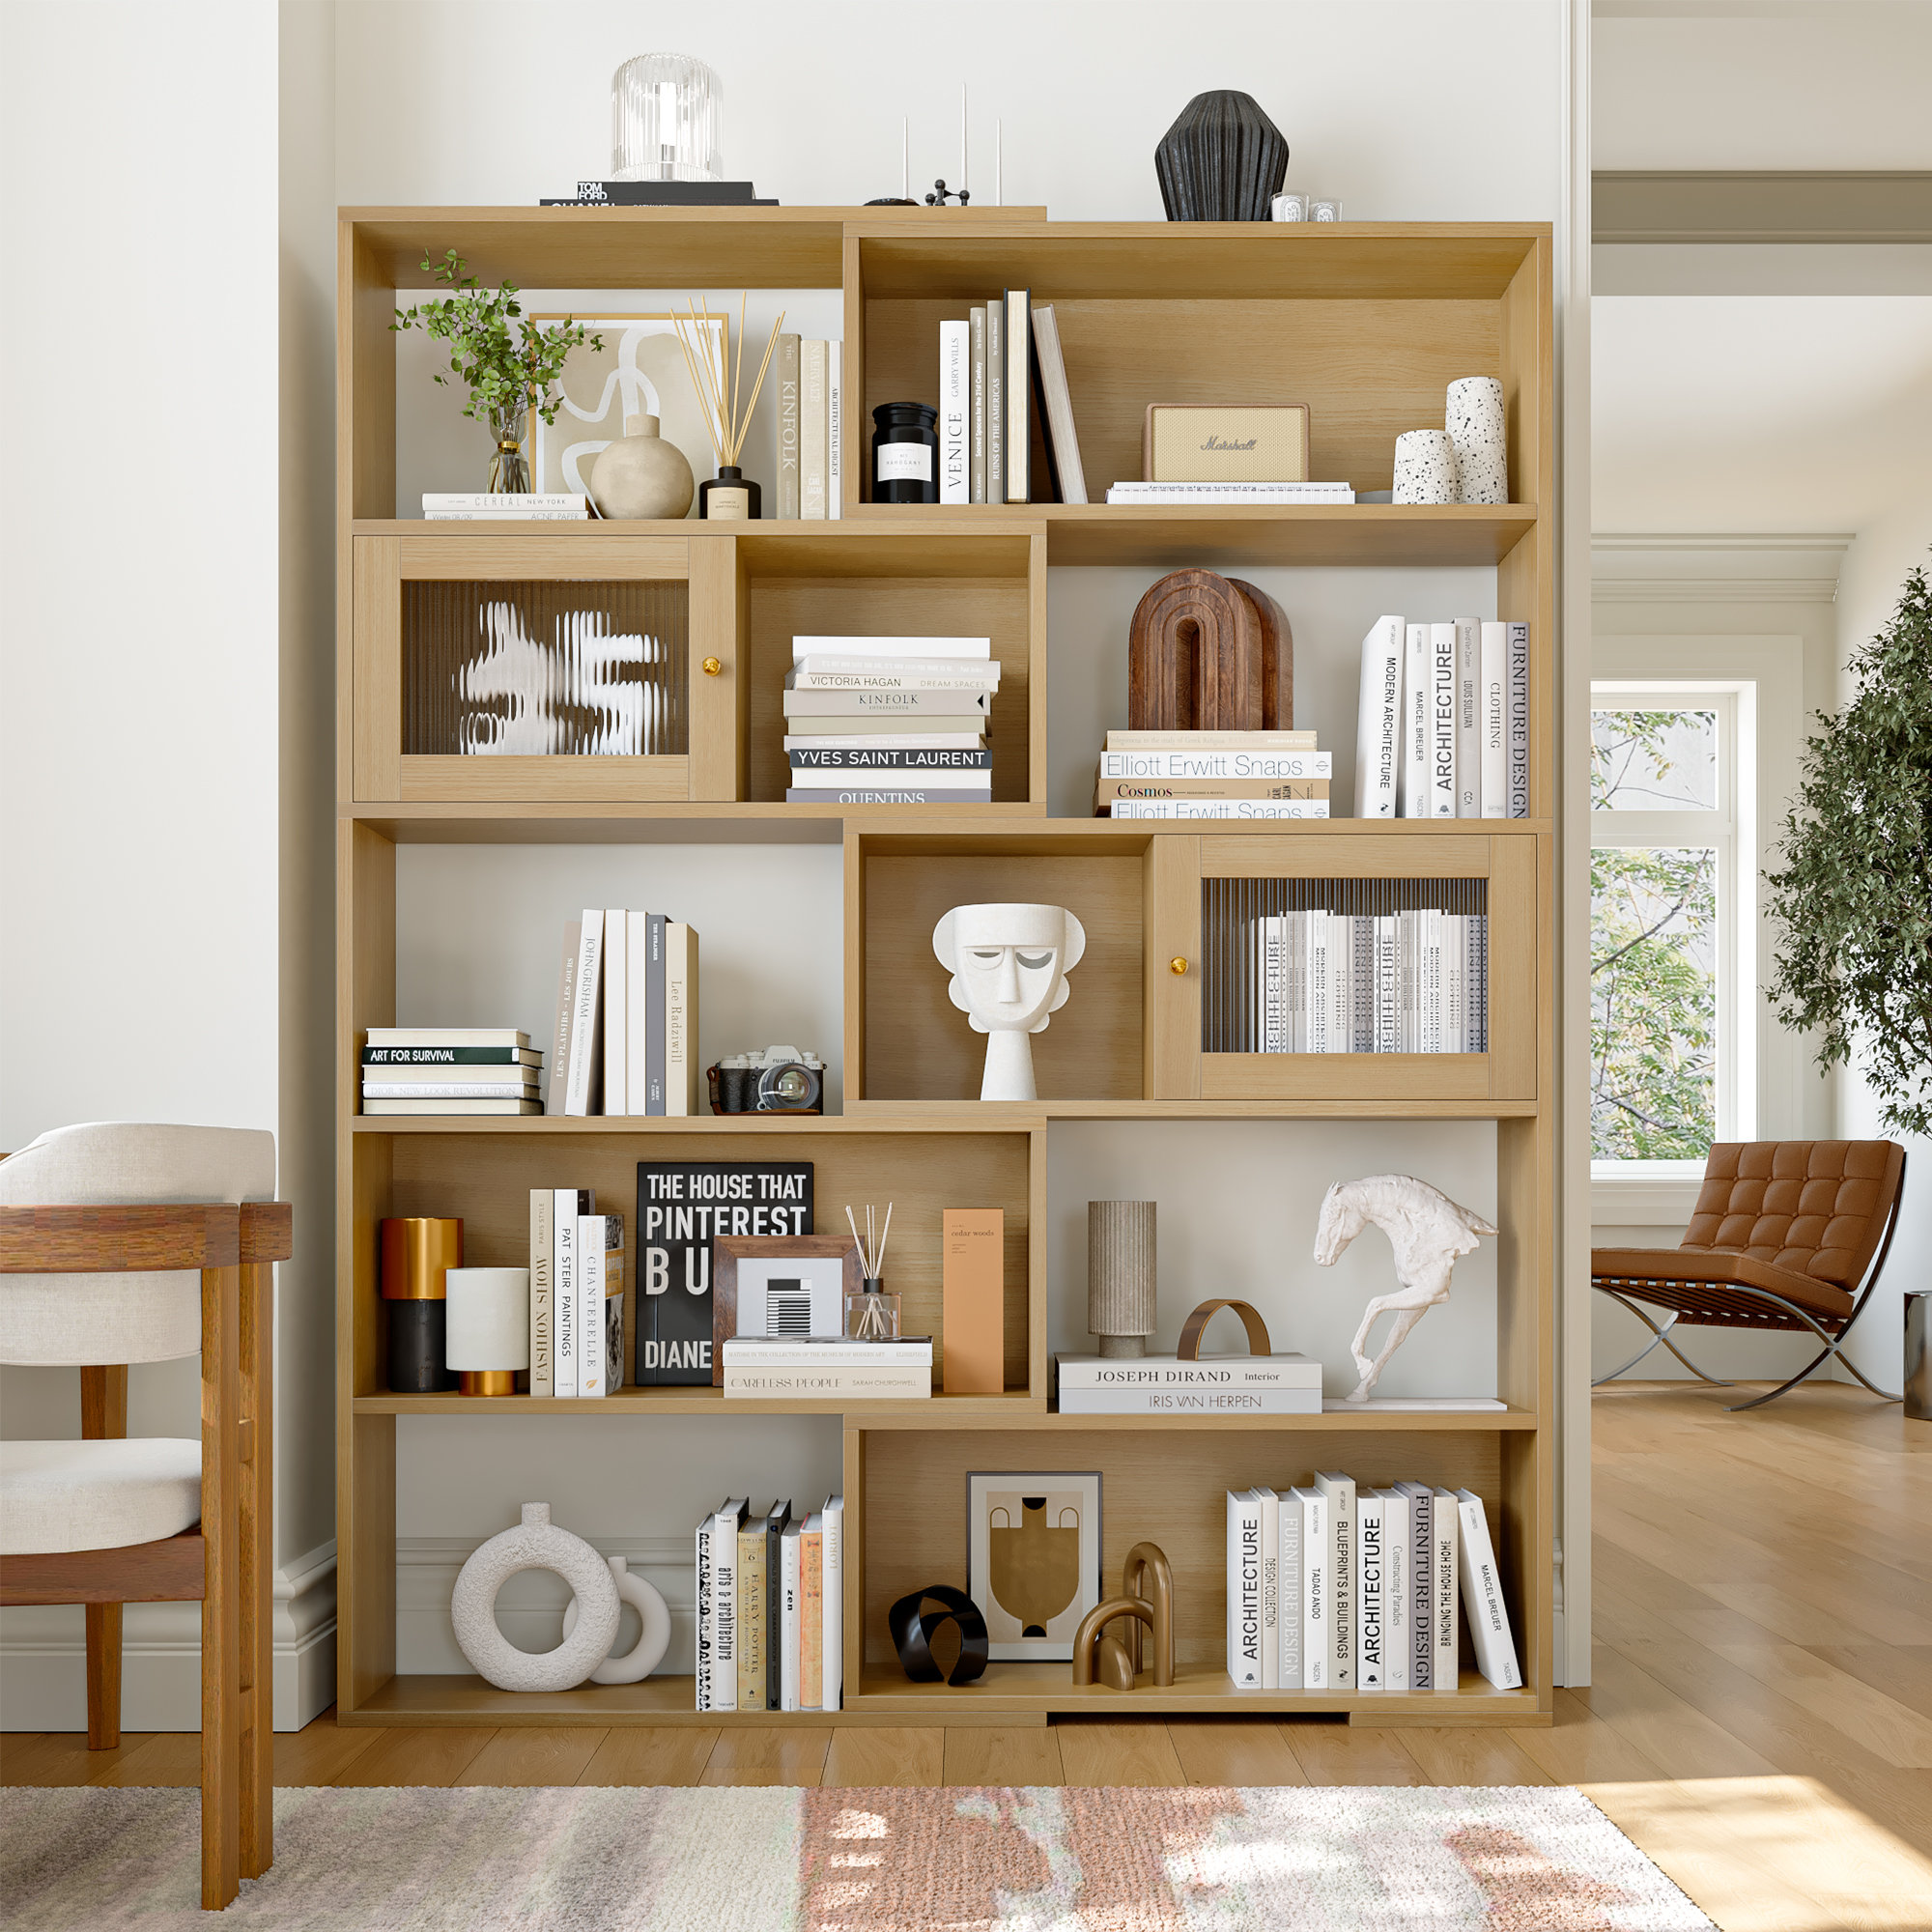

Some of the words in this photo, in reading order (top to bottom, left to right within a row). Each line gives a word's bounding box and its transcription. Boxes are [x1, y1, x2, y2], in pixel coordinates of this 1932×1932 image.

[578, 182, 603, 191] TOM
[578, 191, 608, 200] FORD
[951, 337, 959, 366] WILLS
[951, 369, 959, 397] GARRY
[782, 380, 796, 470] KINFOLK
[949, 412, 962, 489] VENICE
[992, 441, 1000, 453] OF
[1200, 436, 1257, 451] Marshall
[474, 497, 521, 506] CEREAL
[810, 676, 861, 686] VICTORIA
[864, 677, 901, 687] HAGAN
[954, 680, 986, 689] SPACES
[1385, 657, 1397, 703] MODERN
[1463, 680, 1473, 697] LOUIS
[1512, 626, 1526, 742] FURNITURE
[859, 694, 919, 704] KINFOLK
[1415, 691, 1424, 725] MARCEL
[1463, 699, 1473, 728] SULLIVAN
[1435, 643, 1452, 791] ARCHITECTURE
[1490, 682, 1501, 749] CLOTHING
[798, 751, 842, 765] YVES
[848, 752, 899, 765] SAINT
[905, 752, 985, 765] LAURENT
[1379, 706, 1394, 789] ARCHITECTURE
[1415, 727, 1424, 761] BREUER
[1107, 754, 1161, 776] Elliott
[1169, 754, 1228, 776] Erwitt
[1235, 754, 1303, 780] Snaps
[838, 792, 925, 803] QUENTINS
[1117, 783, 1173, 798] Cosmos
[1463, 790, 1473, 806] CCA
[1512, 748, 1526, 819] DESIGN
[1117, 803, 1169, 818] Elliott
[1176, 803, 1231, 818] Erwitt
[1237, 803, 1302, 818] Snaps
[584, 937, 596, 966] JOHN
[565, 957, 574, 984] JOURS
[580, 968, 592, 1018] GRISHAM
[671, 980, 682, 1001] Lee
[557, 1009, 568, 1057] PLAISIRS
[671, 1007, 682, 1064] Radziwill
[370, 1050, 388, 1062] ART
[390, 1050, 411, 1062] FOR
[412, 1050, 455, 1062] SURVIVAL
[556, 1059, 565, 1078] LES
[646, 1174, 684, 1199] THE
[689, 1174, 753, 1199] HOUSE
[757, 1174, 807, 1199] THAT
[646, 1206, 807, 1240] PINTEREST
[561, 1228, 571, 1249] PAT
[535, 1255, 549, 1304] SHOW
[561, 1256, 571, 1288] STEIR
[561, 1295, 571, 1357] PAINTINGS
[586, 1256, 597, 1368] CHANTERELLE
[535, 1311, 549, 1382] FASHION
[644, 1340, 712, 1370] DIANE
[730, 1378, 792, 1388] CARELESS
[796, 1378, 841, 1388] PEOPLE
[1095, 1371, 1159, 1382] JOSEPH
[1165, 1371, 1231, 1382] DIRAND
[1149, 1395, 1173, 1407] IRIS
[1176, 1395, 1205, 1407] VAN
[1209, 1395, 1262, 1407] HERPEN
[1284, 1518, 1299, 1612] FURNITURE
[1337, 1520, 1349, 1588] BLUEPRINTS
[1415, 1495, 1430, 1610] FURNITURE
[1440, 1540, 1452, 1562] HOME
[718, 1567, 732, 1586] arts
[1264, 1557, 1276, 1584] DESIGN
[1312, 1568, 1321, 1595] TADAO
[1391, 1545, 1403, 1593] Constructing
[1440, 1565, 1452, 1590] HOUSE
[1242, 1520, 1258, 1661] ARCHITECTURE
[1337, 1590, 1349, 1599] &
[1364, 1518, 1380, 1664] ARCHITECTURE
[1440, 1592, 1452, 1606] THE
[1480, 1564, 1494, 1598] MARCEL
[1488, 1599, 1502, 1632] BREUER
[1264, 1585, 1276, 1628] COLLECTION
[1312, 1596, 1321, 1620] ANDO
[718, 1602, 734, 1661] architecture
[1337, 1602, 1349, 1660] BUILDINGS
[1440, 1608, 1452, 1647] BRINGING
[1284, 1616, 1299, 1676] DESIGN
[1415, 1616, 1430, 1689] DESIGN
[1502, 1662, 1514, 1684] TASCEN
